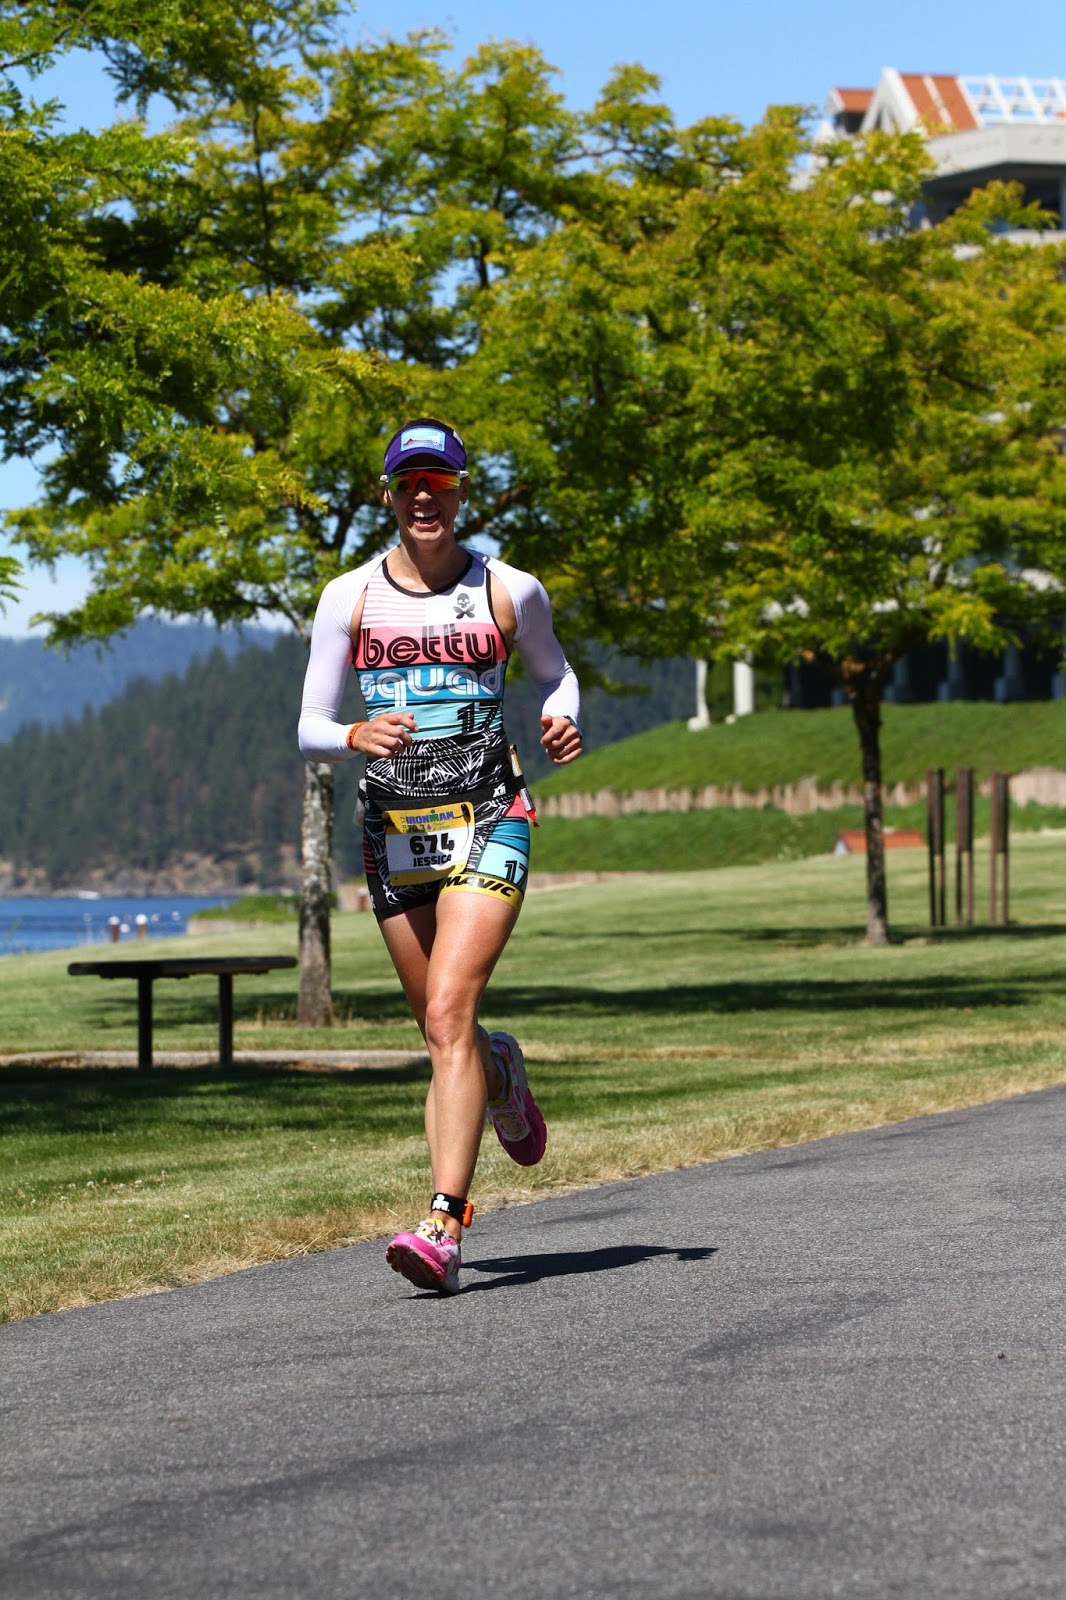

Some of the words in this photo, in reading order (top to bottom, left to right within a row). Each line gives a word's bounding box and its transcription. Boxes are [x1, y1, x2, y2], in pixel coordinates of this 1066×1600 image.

[362, 624, 497, 668] betty
[359, 660, 501, 707] squad
[405, 810, 454, 824] IRONMAN
[409, 833, 455, 855] 674
[505, 860, 528, 887] 17
